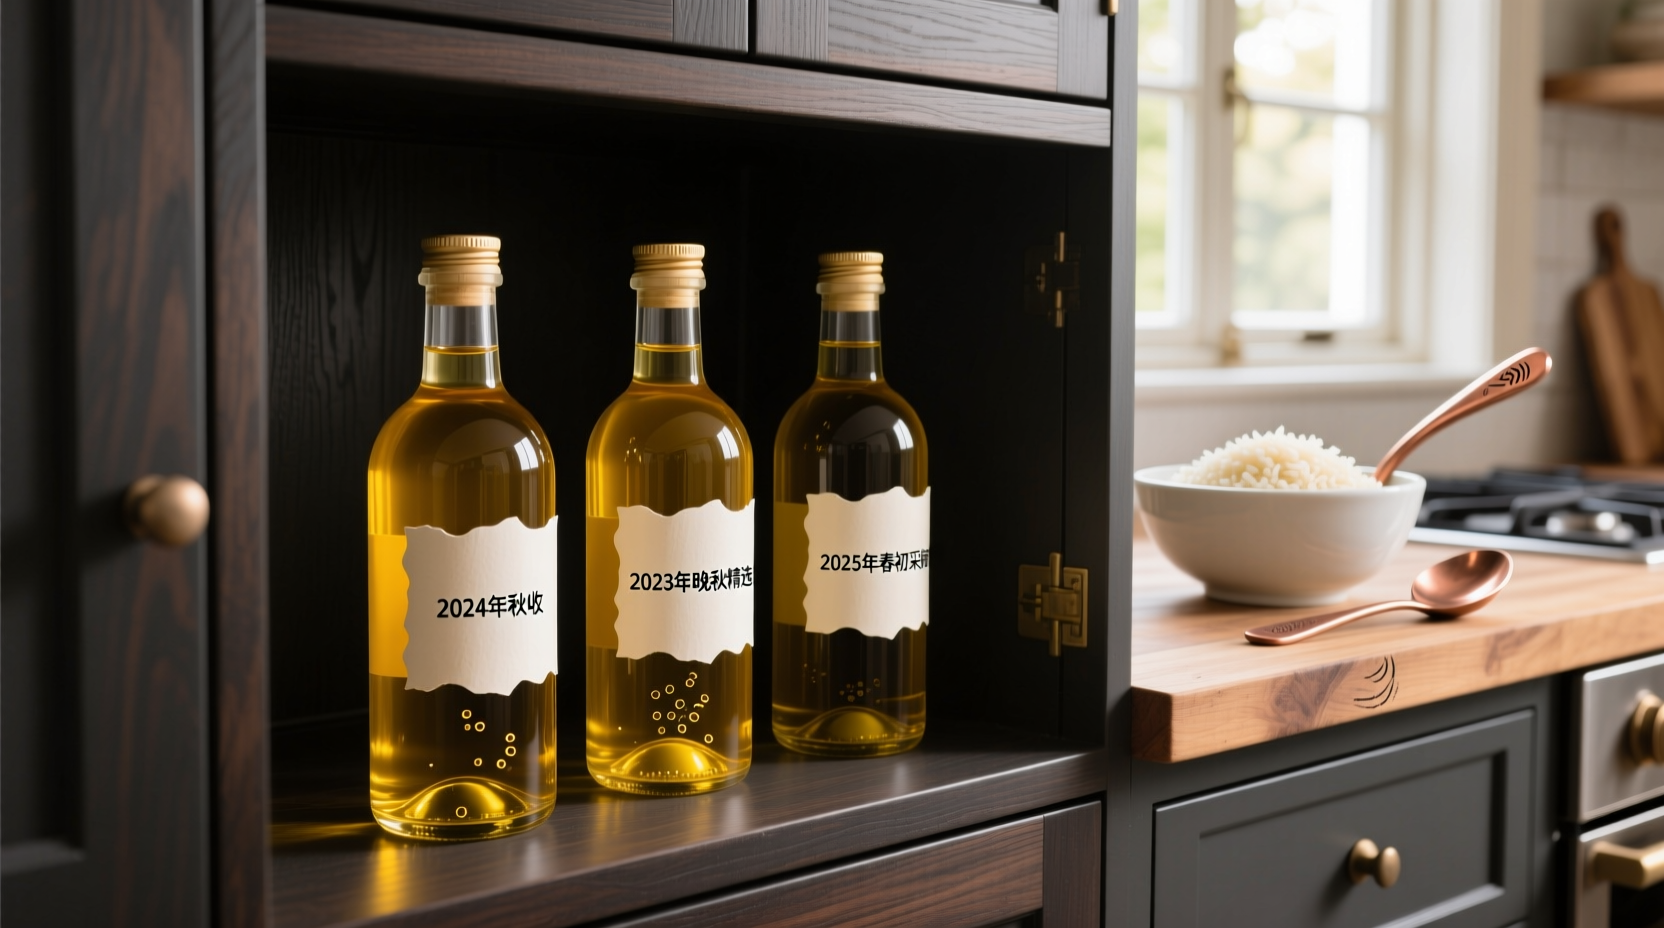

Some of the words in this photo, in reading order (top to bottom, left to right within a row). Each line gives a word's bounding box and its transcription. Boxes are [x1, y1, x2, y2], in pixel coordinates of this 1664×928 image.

[629, 565, 753, 593] 2023年晚秋精选
[436, 590, 544, 618] 2024年秋收
